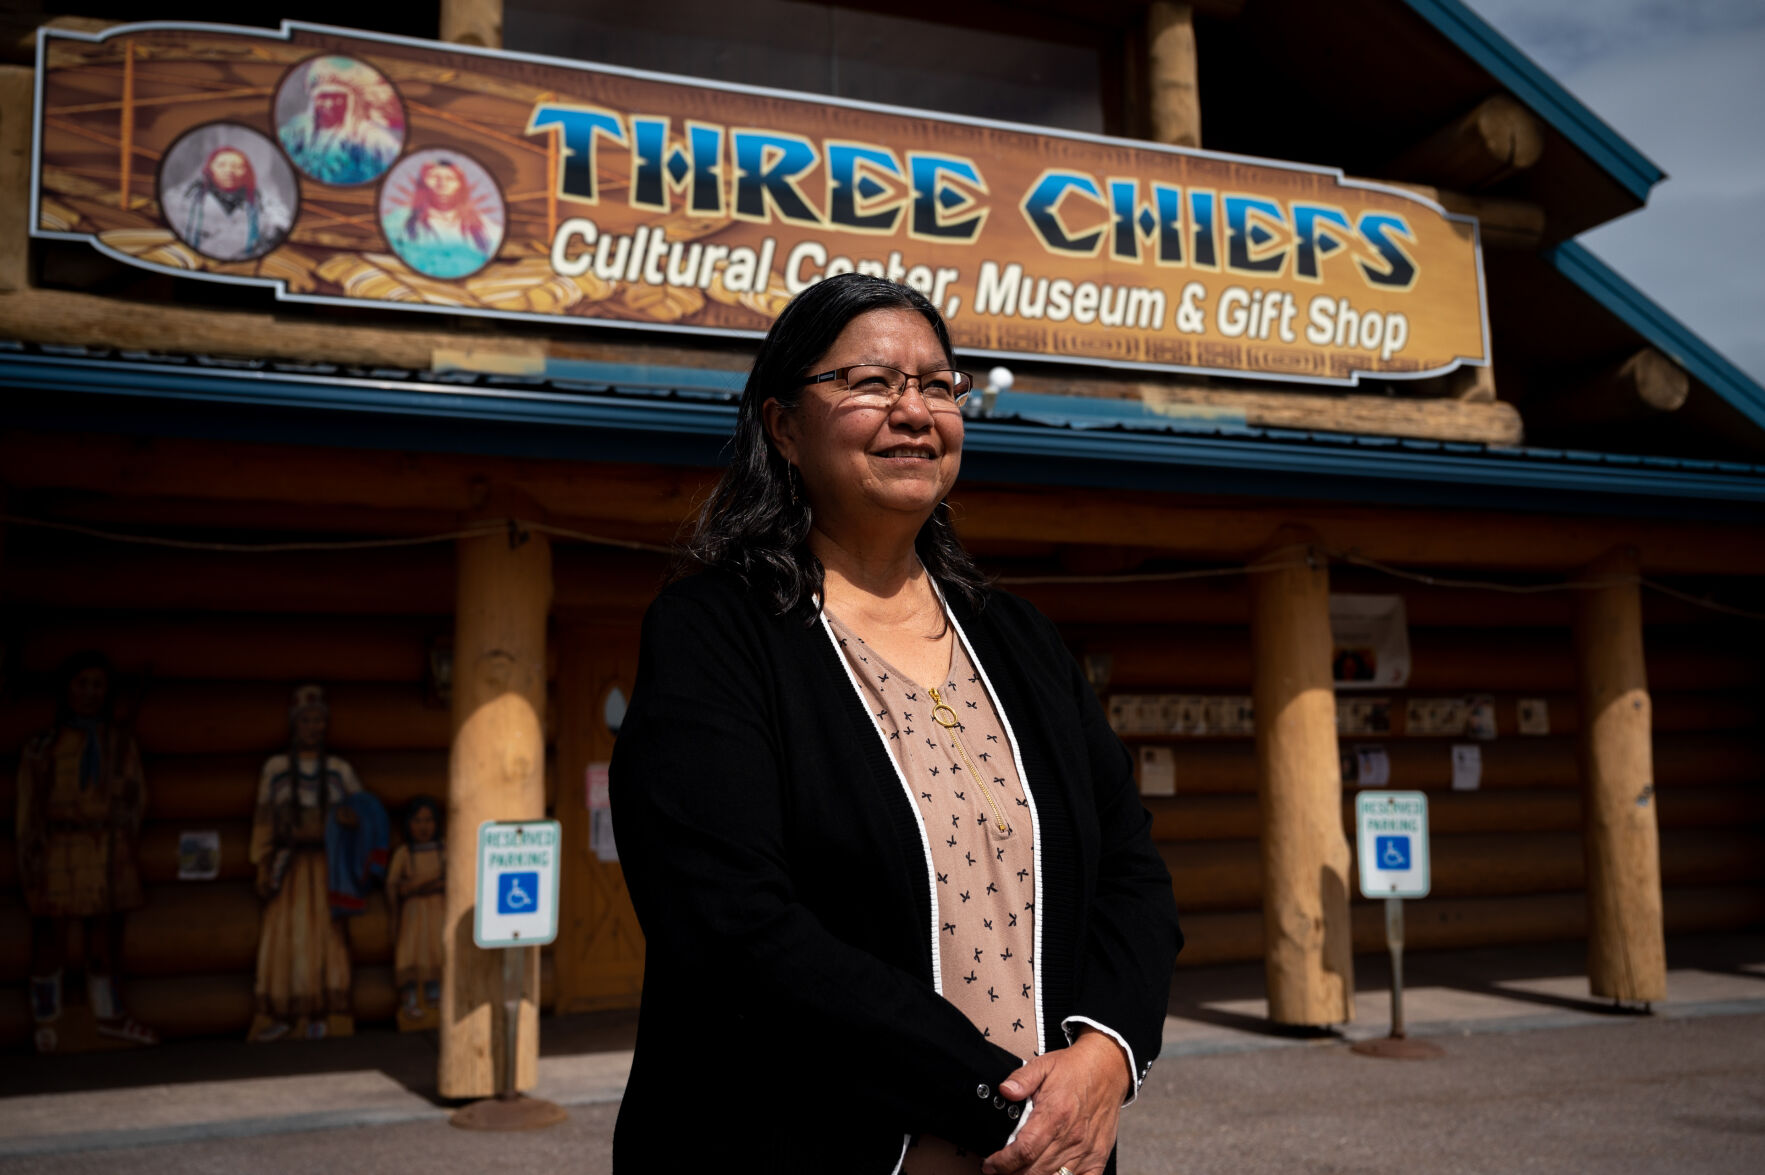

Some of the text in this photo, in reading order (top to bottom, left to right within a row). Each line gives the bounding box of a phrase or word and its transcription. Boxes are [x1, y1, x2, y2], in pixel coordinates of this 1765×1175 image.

[525, 102, 1420, 293] THREE CHIEFS
[550, 217, 776, 294] Cultural
[975, 261, 1166, 331] Museum
[1177, 281, 1207, 335] &
[1216, 285, 1298, 344] Gift
[1306, 294, 1409, 361] Shop
[1367, 819, 1418, 831] PARKING
[486, 830, 556, 846] RESERVED
[490, 851, 549, 867] PARKING
